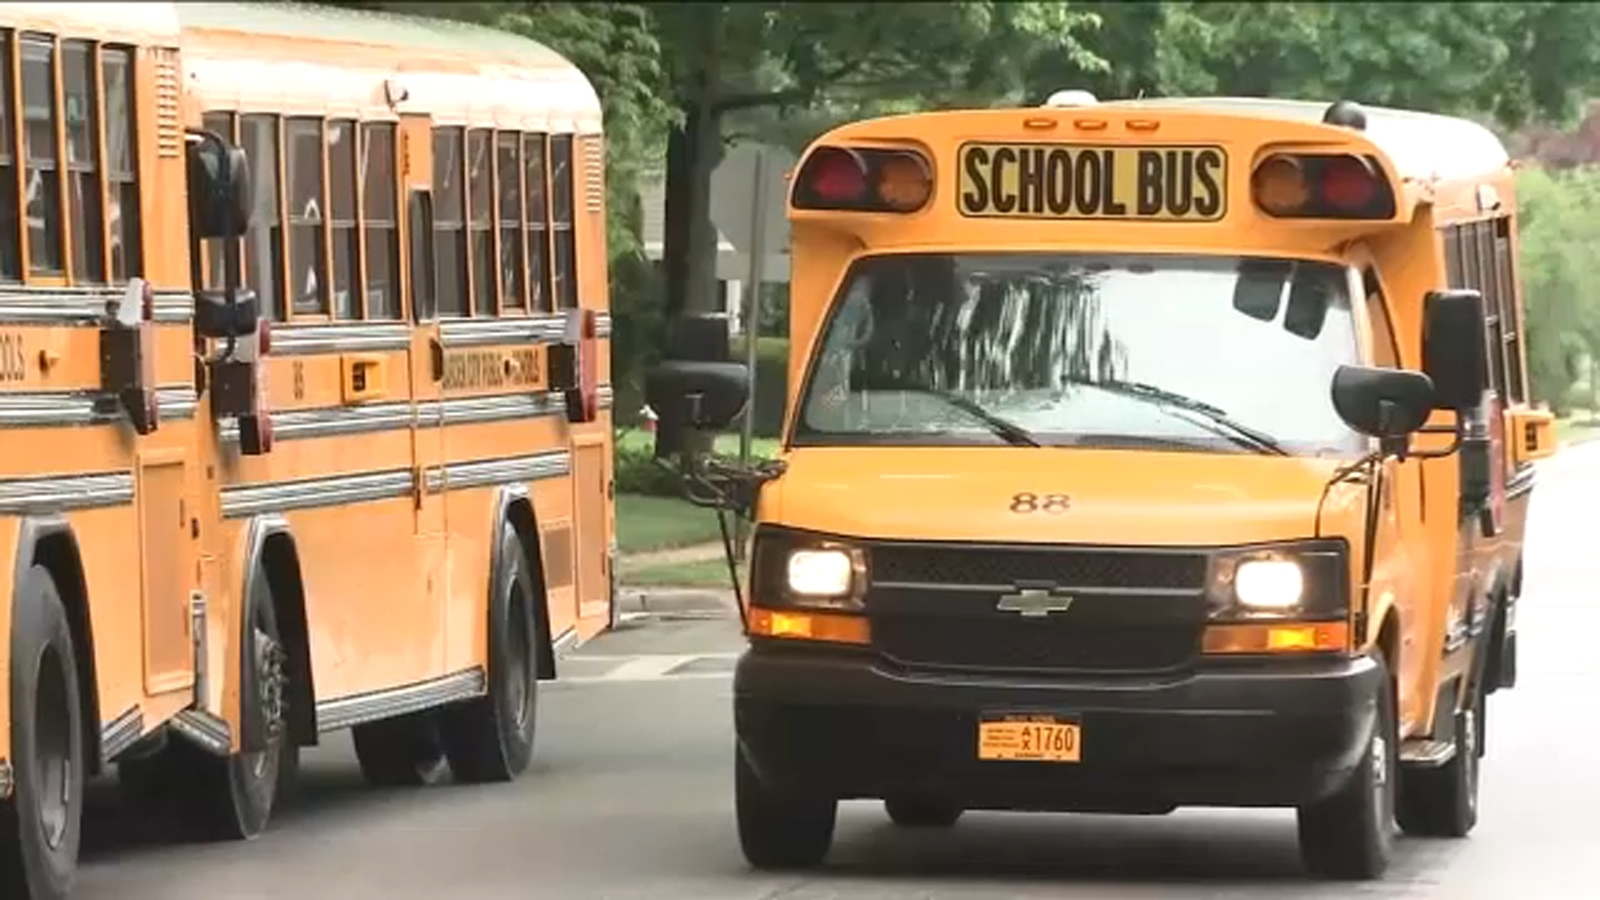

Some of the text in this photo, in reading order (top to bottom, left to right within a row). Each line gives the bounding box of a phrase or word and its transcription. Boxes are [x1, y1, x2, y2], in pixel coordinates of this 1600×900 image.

[962, 146, 1221, 217] SCHOOL BUS
[1009, 492, 1070, 513] 88
[1033, 726, 1074, 752] 1760
